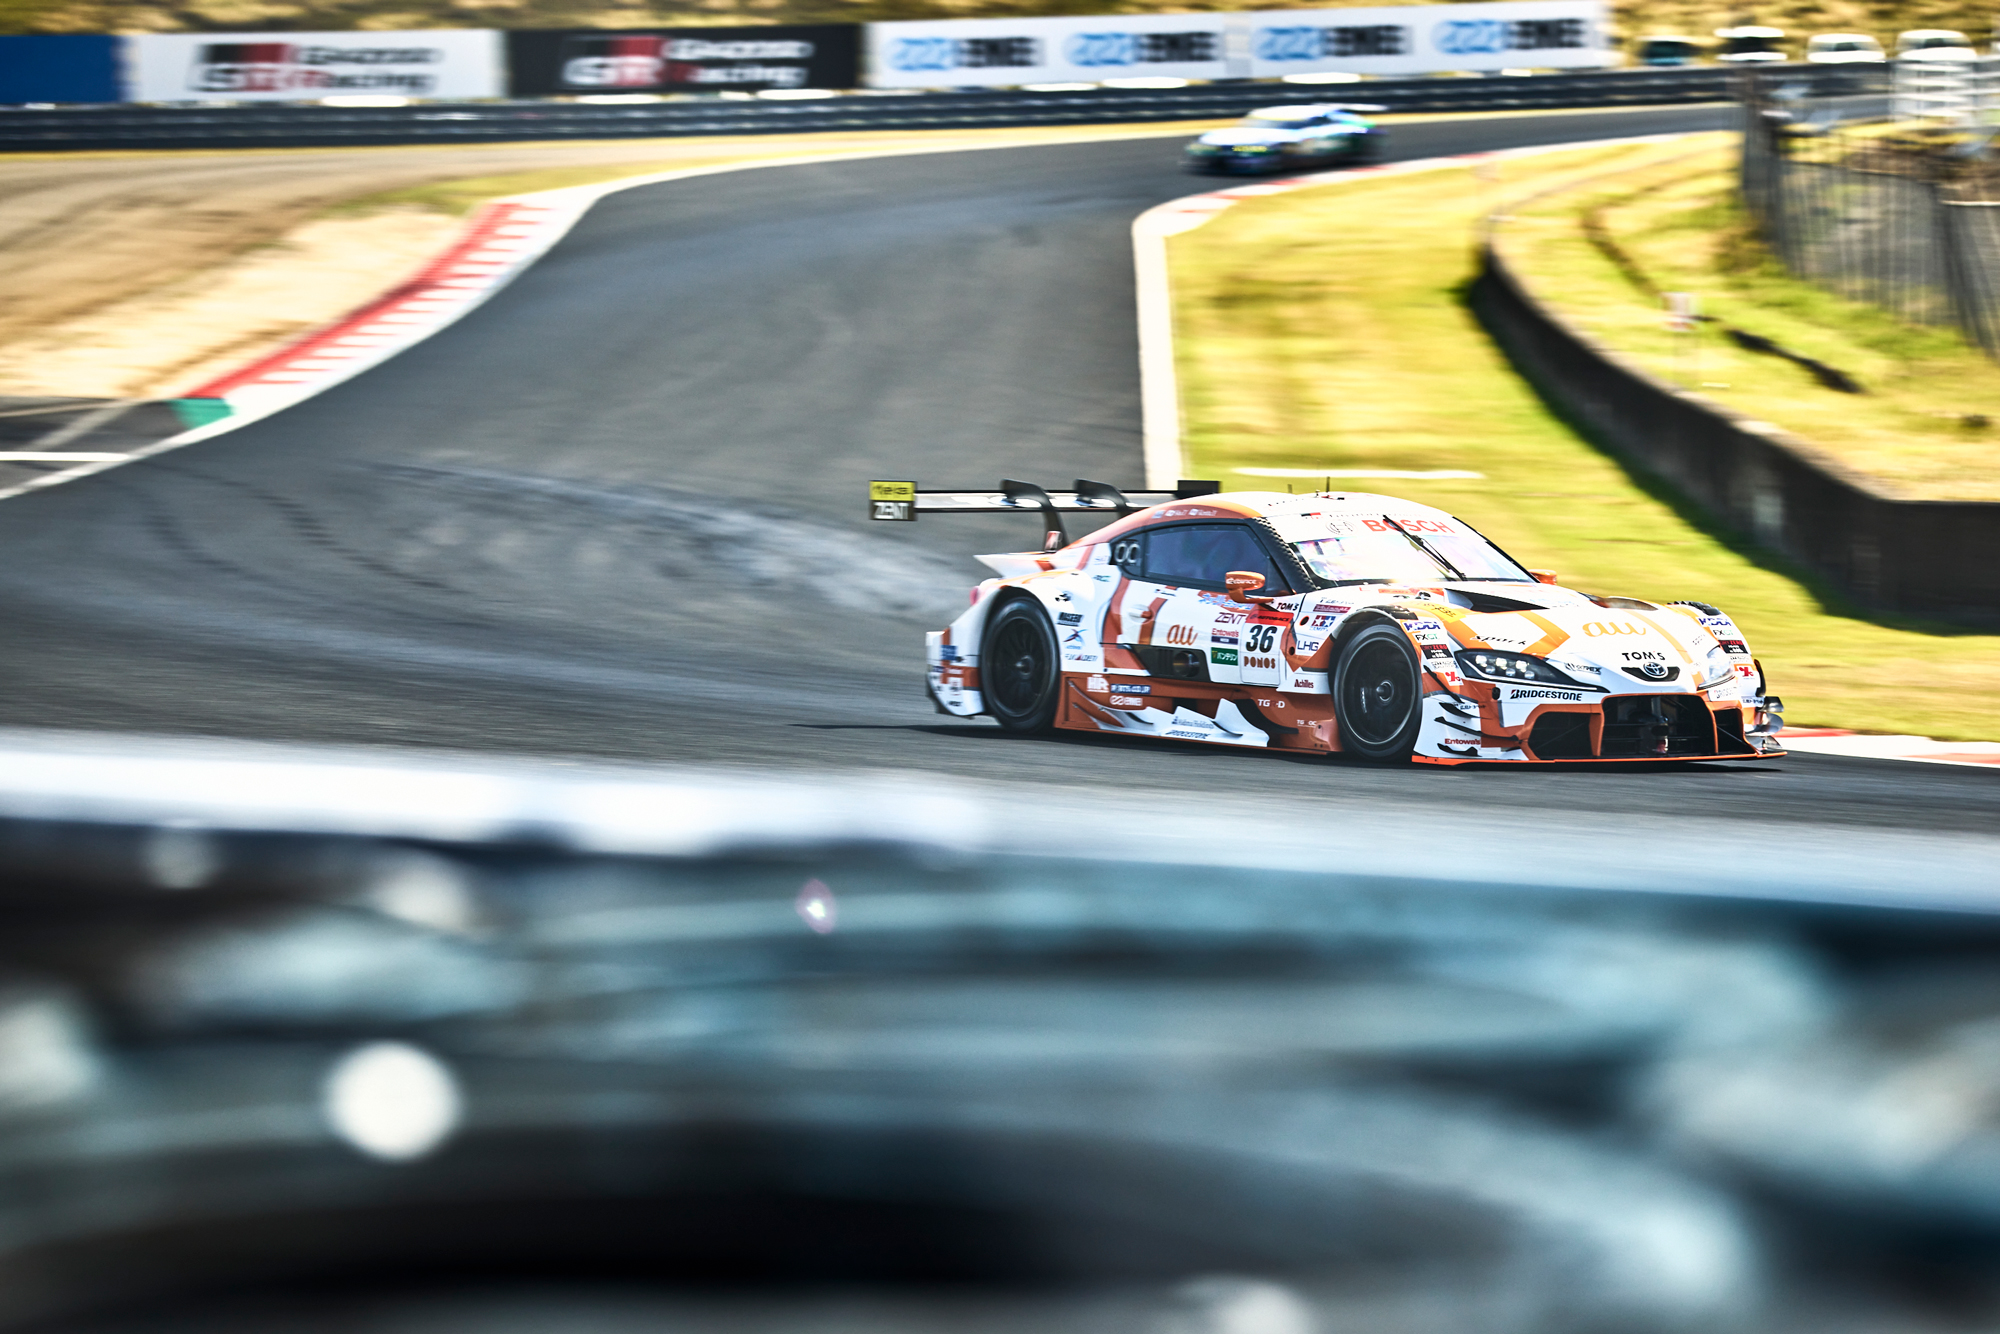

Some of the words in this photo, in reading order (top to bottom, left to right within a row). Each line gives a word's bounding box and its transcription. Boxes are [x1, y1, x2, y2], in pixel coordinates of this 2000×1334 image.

[1362, 519, 1456, 534] BOSCH
[1215, 612, 1247, 625] ZENT
[1167, 624, 1198, 645] au
[1582, 622, 1646, 637] au
[1246, 625, 1277, 653] 36
[1297, 640, 1320, 652] LHG
[1244, 656, 1276, 669] PONOS
[1294, 679, 1315, 689] Achilles
[1510, 689, 1583, 701] BRIDGESTONE
